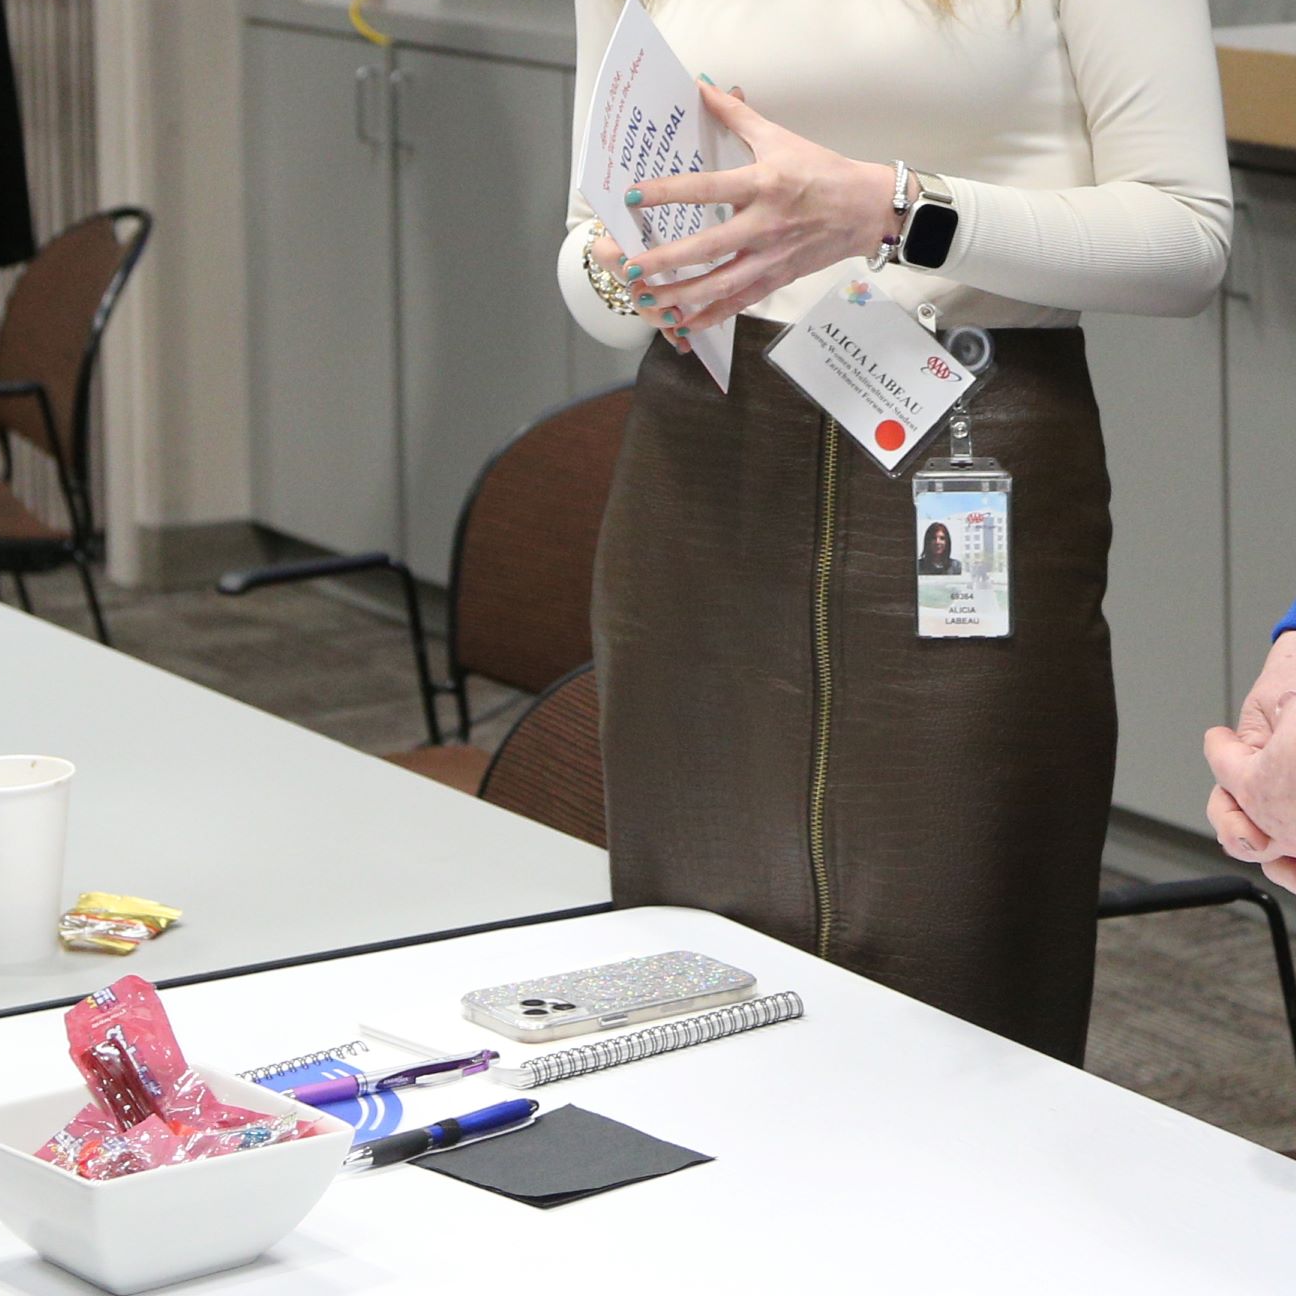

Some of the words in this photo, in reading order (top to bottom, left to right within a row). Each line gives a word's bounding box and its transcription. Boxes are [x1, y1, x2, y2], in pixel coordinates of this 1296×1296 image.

[619, 105, 642, 172] YOUNG
[657, 150, 684, 239] STUNT
[806, 325, 827, 350] Young
[827, 347, 852, 372] Women
[850, 365, 893, 409] Multicultural
[893, 403, 918, 433] Student
[820, 322, 870, 367] ALICIA
[868, 362, 925, 416] LABEAU
[825, 357, 862, 394] Enrichment
[861, 389, 884, 415] Forum
[945, 617, 979, 625] LABEAU
